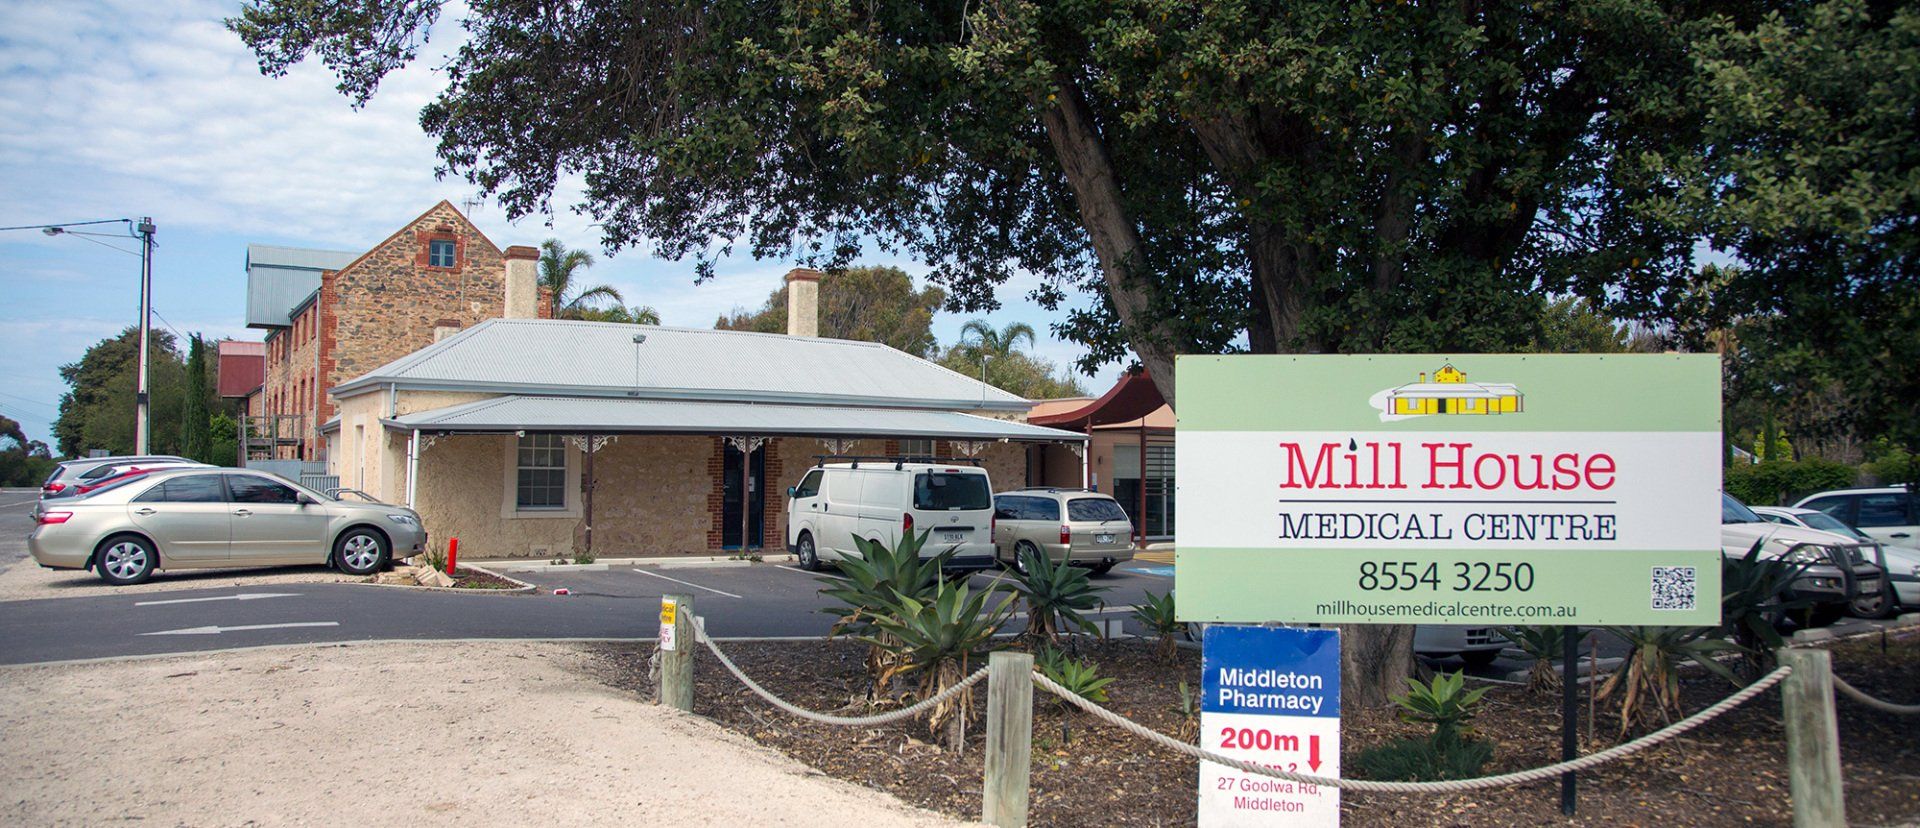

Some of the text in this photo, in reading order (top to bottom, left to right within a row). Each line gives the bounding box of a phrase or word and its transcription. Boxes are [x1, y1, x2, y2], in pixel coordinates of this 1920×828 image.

[1279, 437, 1616, 491] Mill House
[1278, 513, 1617, 541] MEDICAL CENTRE
[1358, 561, 1535, 592] 8554 3250
[1316, 600, 1577, 618] millhousemedicalcentre.com.au
[1219, 668, 1323, 689] Middleton
[1219, 688, 1323, 714] Pharmacy
[1220, 727, 1299, 751] 200m
[1217, 777, 1235, 790] 27
[1240, 778, 1293, 794] Goolwa
[1234, 796, 1304, 812] Middleton
